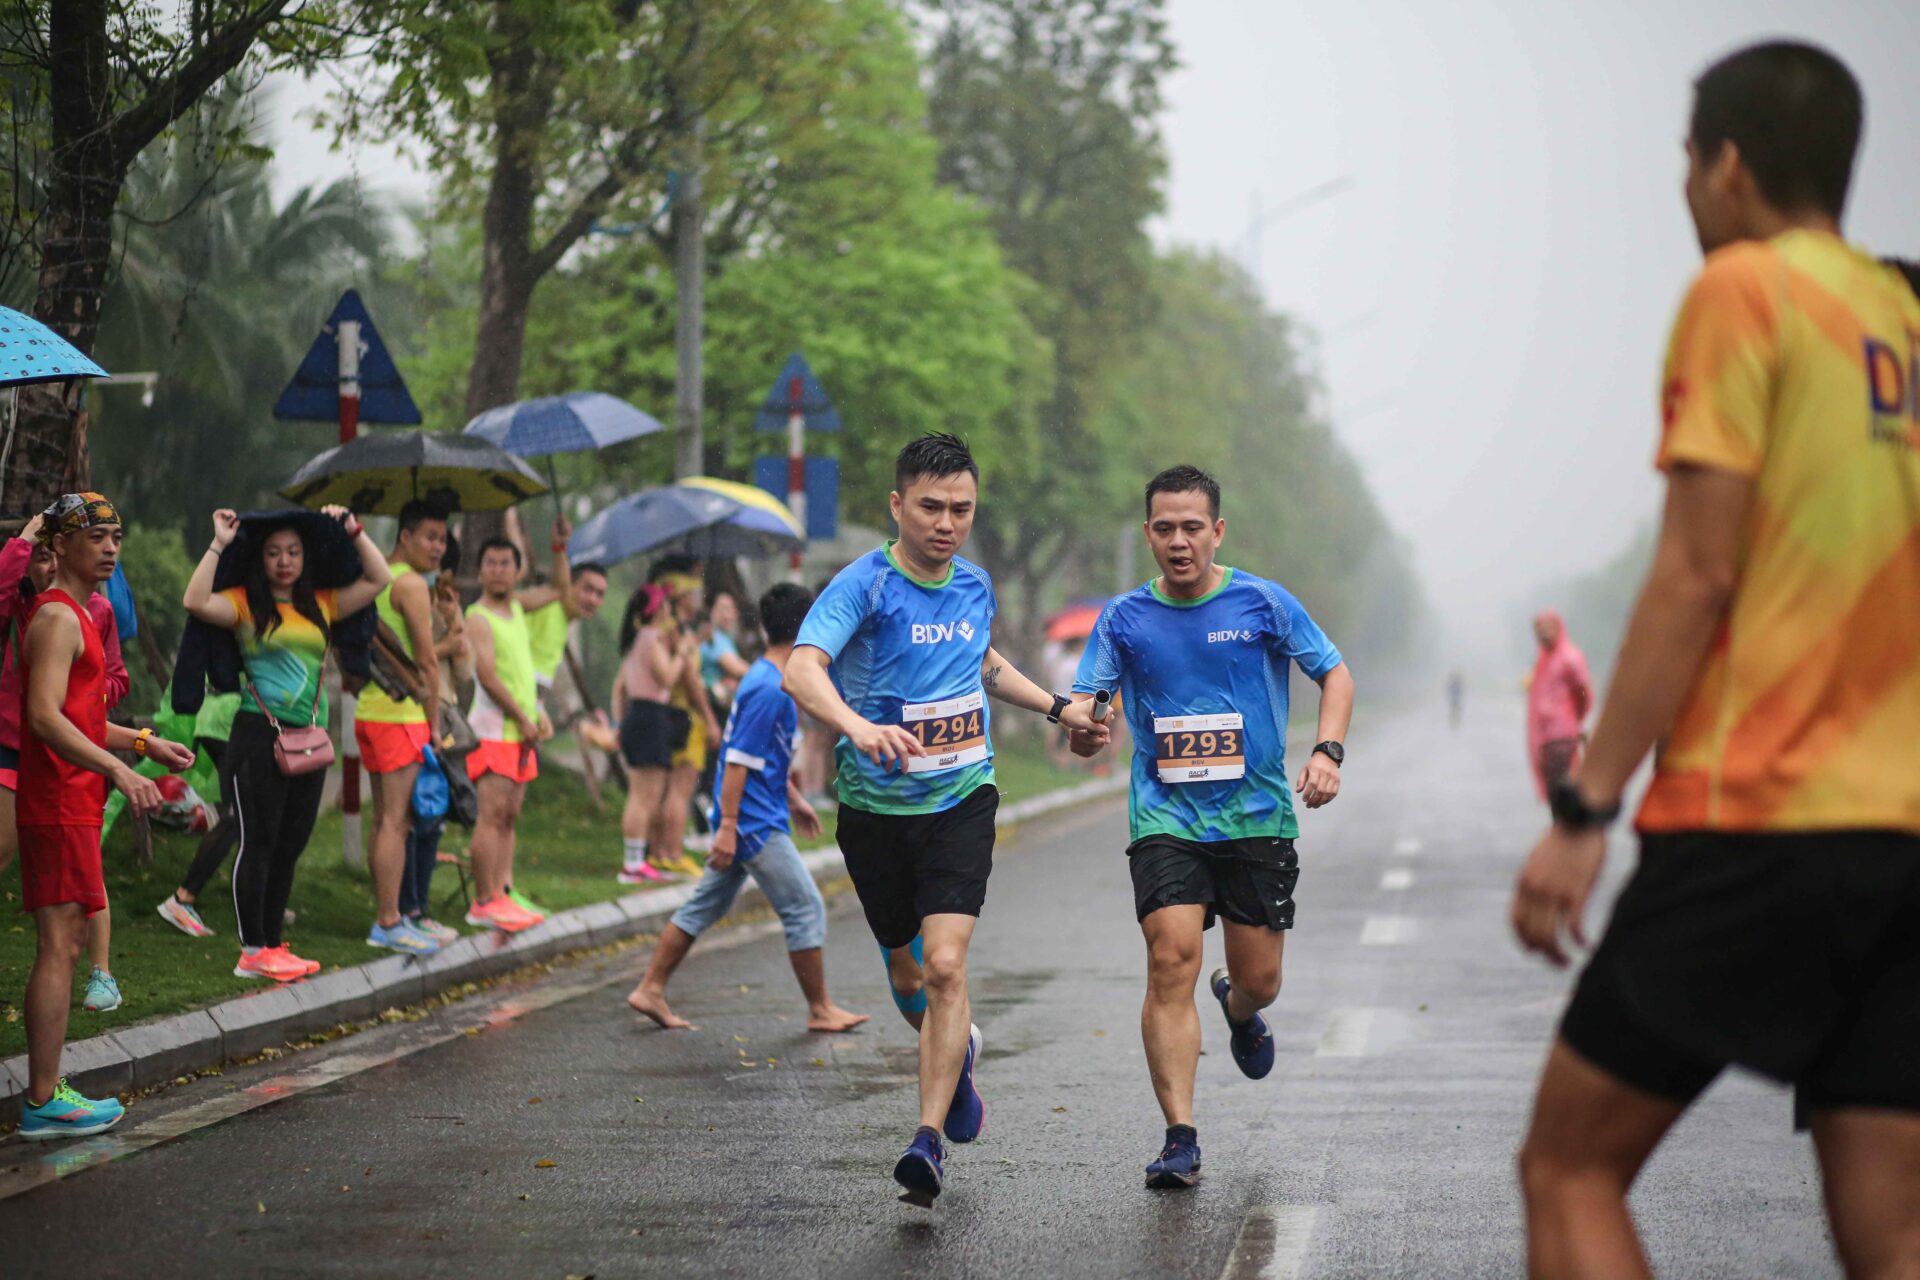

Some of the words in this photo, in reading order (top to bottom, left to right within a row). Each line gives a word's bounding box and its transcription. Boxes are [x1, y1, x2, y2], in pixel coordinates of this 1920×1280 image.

[911, 621, 956, 644] BIDV
[1207, 629, 1240, 643] BIDV
[913, 712, 980, 745] 1294
[1163, 731, 1237, 757] 1293
